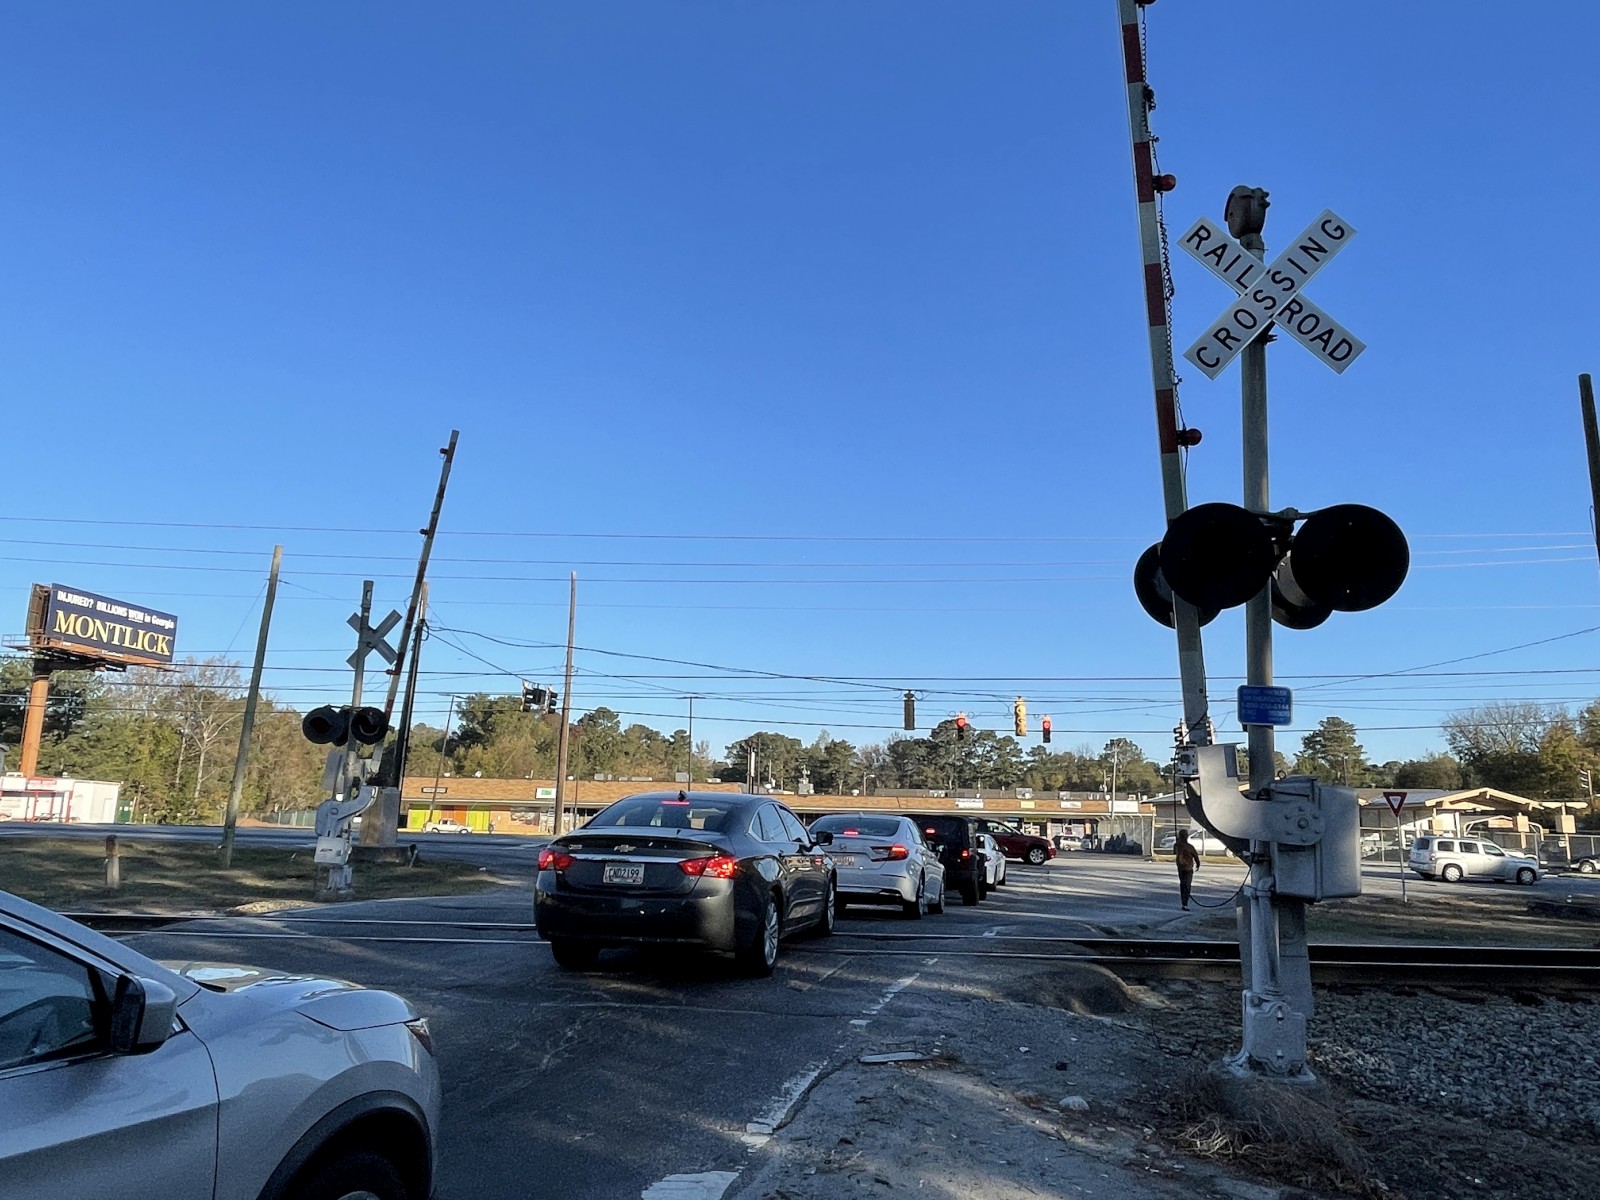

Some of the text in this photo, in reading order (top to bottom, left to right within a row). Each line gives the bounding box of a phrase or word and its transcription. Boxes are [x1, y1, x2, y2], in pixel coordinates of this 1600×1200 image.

[1186, 224, 1353, 362] RAIL ROAD
[1196, 219, 1346, 368] CROSSING
[52, 609, 170, 656] MONTLICK
[57, 590, 175, 630] INJURED? BILLIONS WON in Georgia
